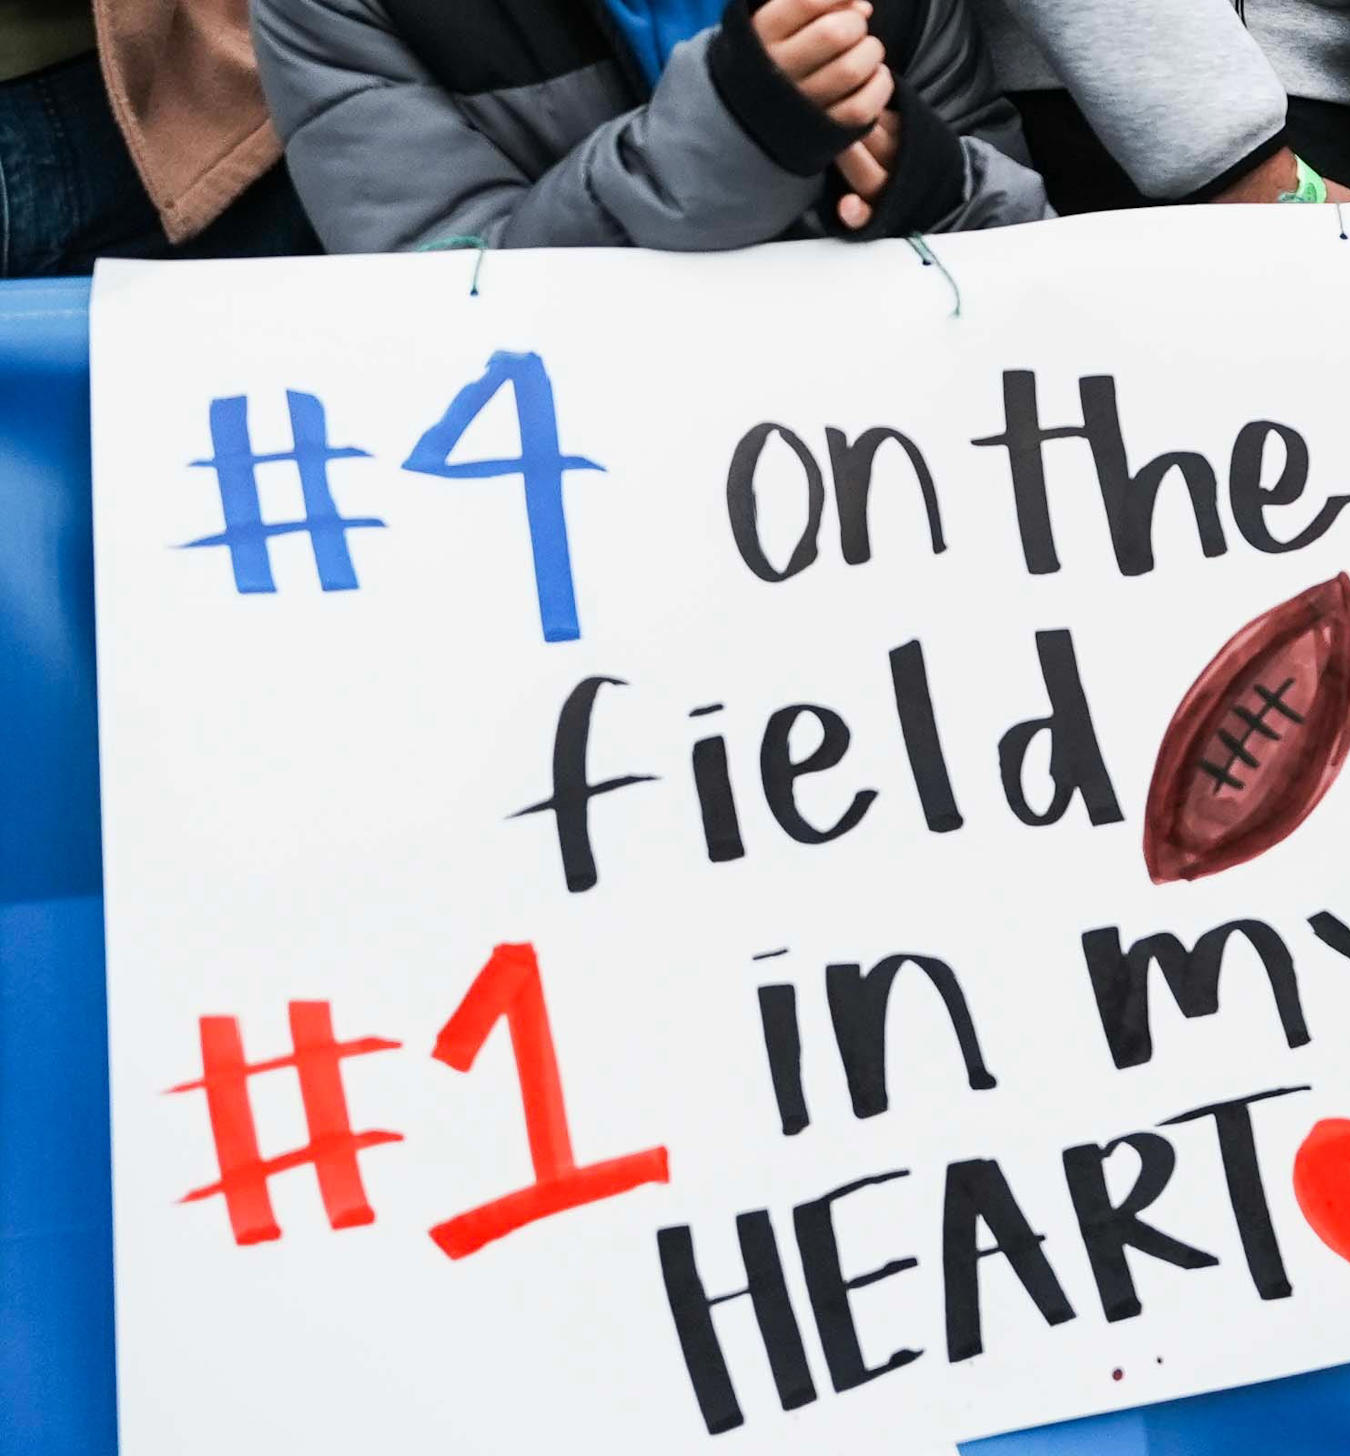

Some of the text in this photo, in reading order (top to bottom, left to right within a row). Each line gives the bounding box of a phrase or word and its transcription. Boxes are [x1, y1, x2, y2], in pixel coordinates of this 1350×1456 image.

[172, 350, 608, 642] #4
[726, 420, 947, 583] on
[506, 629, 1126, 892] field
[161, 941, 670, 1261] #1
[750, 948, 997, 1136] in
[655, 1084, 1312, 1436] HEART
